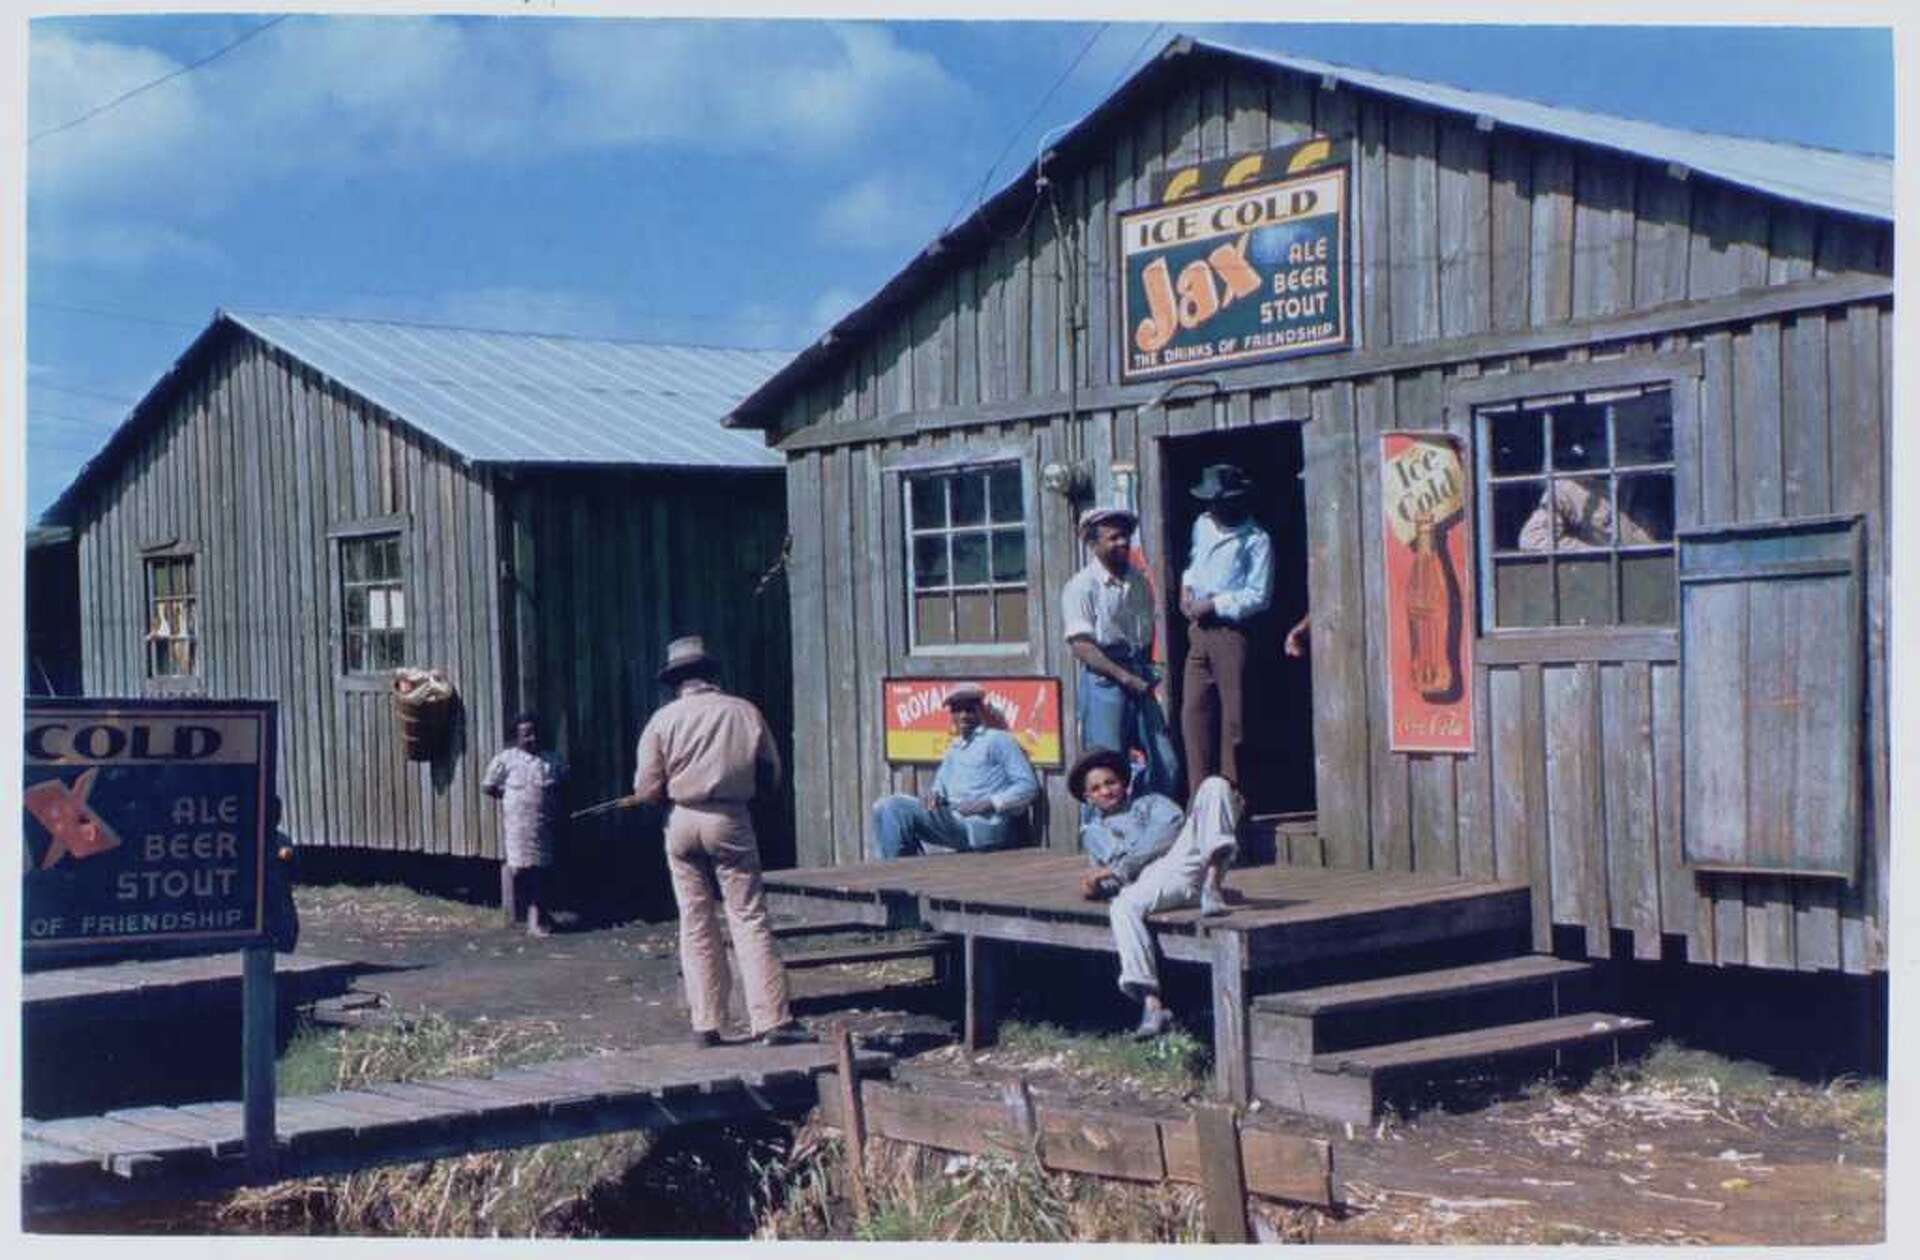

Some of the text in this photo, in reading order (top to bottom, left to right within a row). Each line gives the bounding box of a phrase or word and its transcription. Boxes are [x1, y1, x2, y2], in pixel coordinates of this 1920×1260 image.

[1139, 189, 1319, 247] ICE COLD
[1288, 237, 1328, 265] ALE
[1135, 231, 1263, 352] Jax
[1273, 265, 1328, 293] BEER
[1259, 291, 1329, 324] STOUT
[1133, 322, 1334, 368] THE DRINKS OF FRIENDSHIP
[1395, 449, 1441, 489] Ice
[1396, 466, 1461, 521] Cold
[24, 723, 223, 760] COLD
[171, 795, 239, 825] ALE
[144, 832, 239, 862] BEER
[117, 869, 238, 900] STOUT
[30, 909, 242, 937] OF FRIENDSHIP
